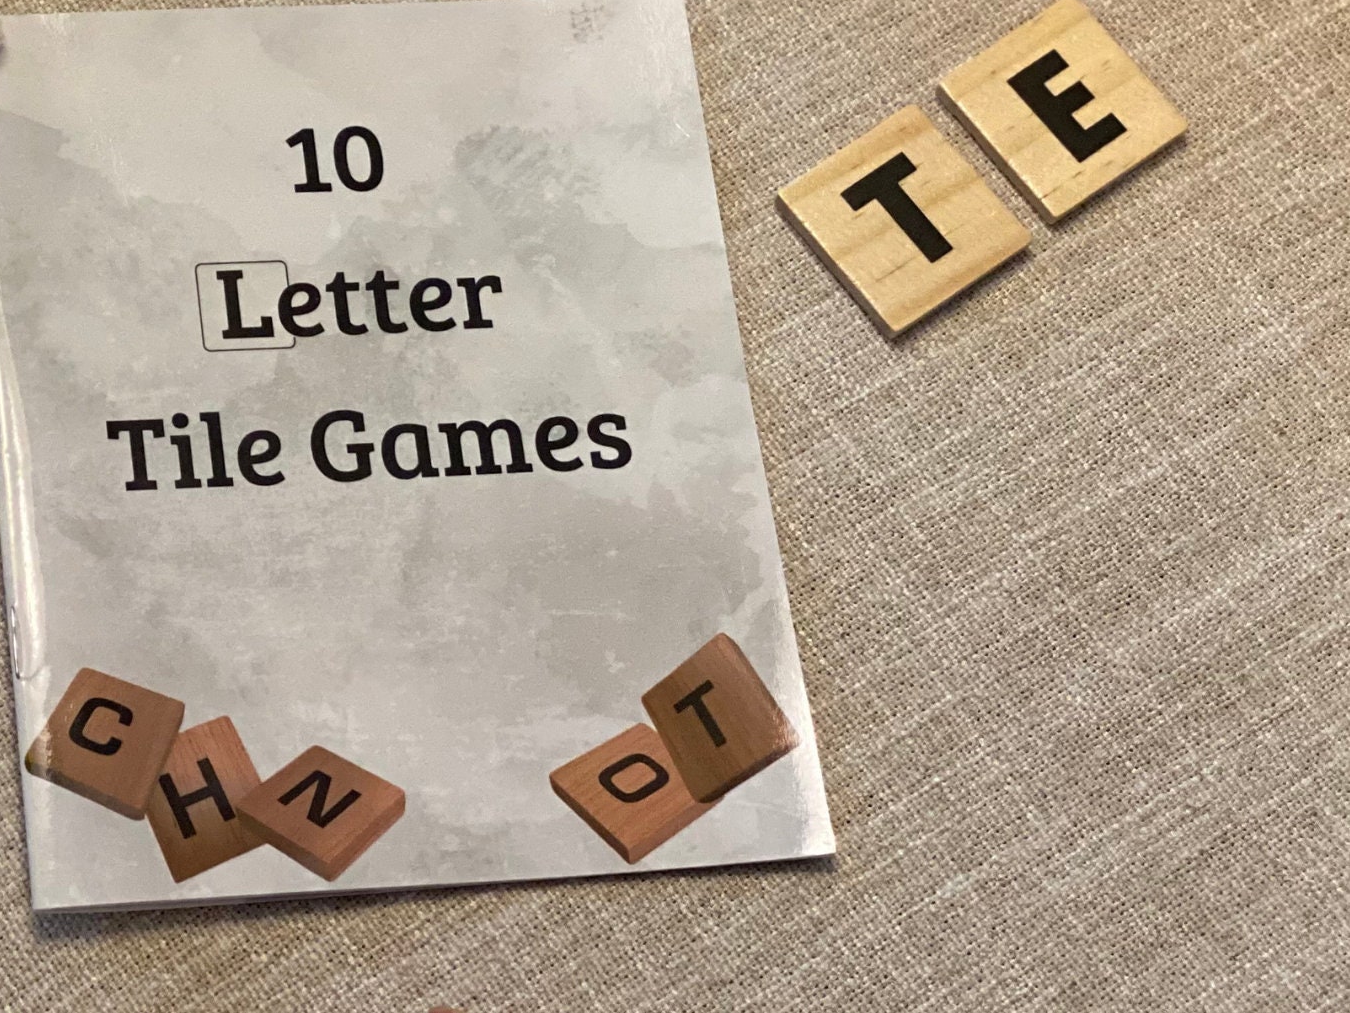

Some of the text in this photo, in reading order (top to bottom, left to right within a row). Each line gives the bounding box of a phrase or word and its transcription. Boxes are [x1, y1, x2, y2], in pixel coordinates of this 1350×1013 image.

[285, 125, 384, 194] 10
[840, 49, 1128, 264] T E
[215, 268, 503, 340] Letter
[105, 409, 633, 492] Tile Games
[68, 697, 134, 757] C
[672, 679, 728, 749] T
[158, 757, 238, 840] H
[277, 769, 362, 829] N
[597, 752, 670, 804] O
